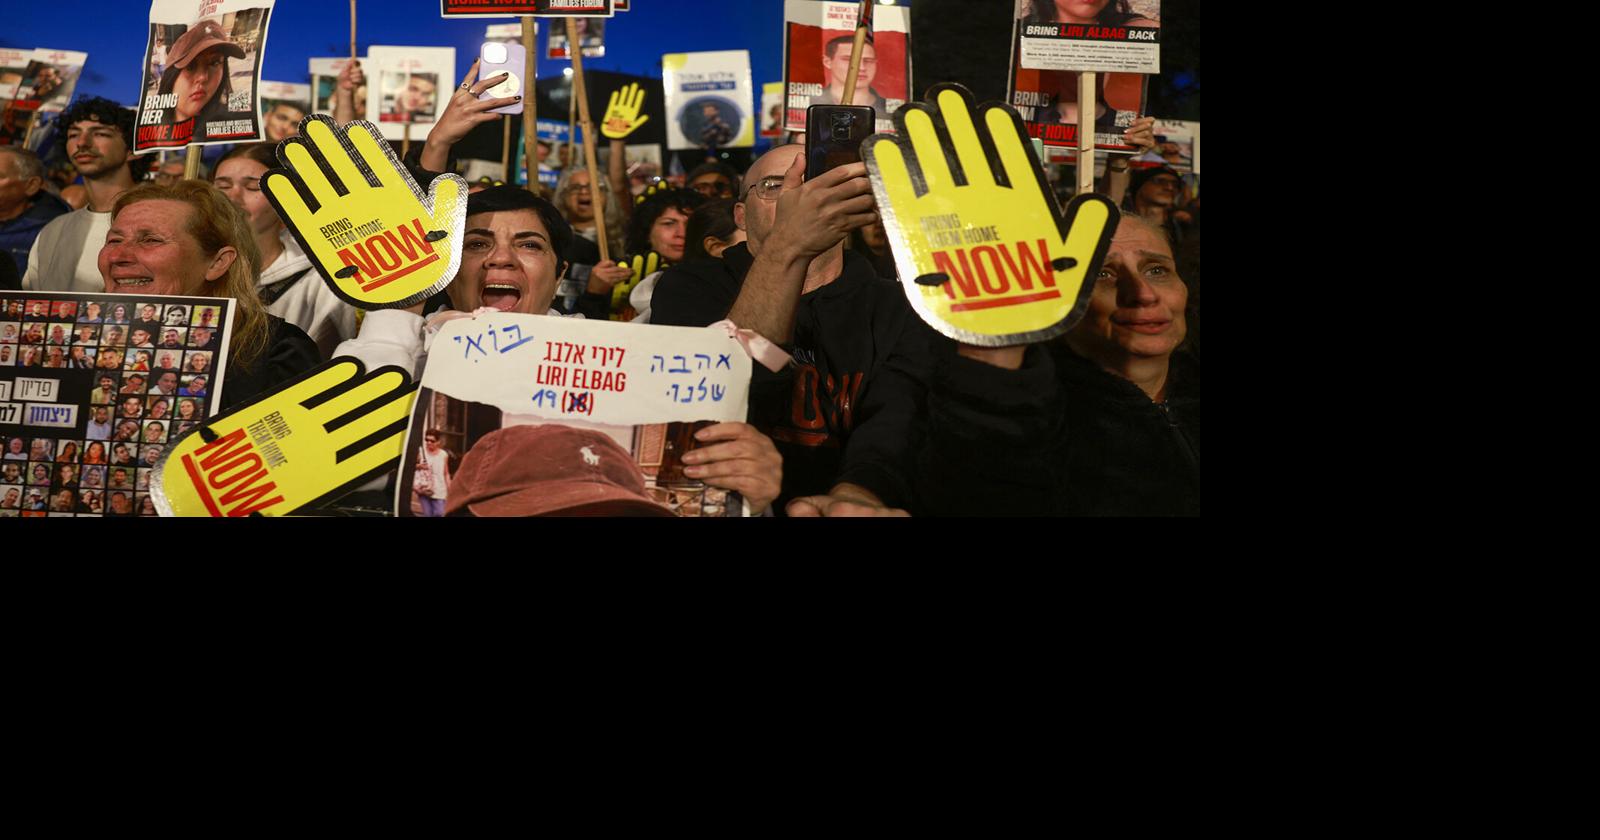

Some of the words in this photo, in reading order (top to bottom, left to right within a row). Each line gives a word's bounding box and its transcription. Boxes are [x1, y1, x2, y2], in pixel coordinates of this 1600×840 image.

[1026, 25, 1058, 36] BRING
[1060, 25, 1084, 37] LIRI
[1086, 26, 1126, 39] ALBAG
[1128, 30, 1156, 41] BACK
[789, 83, 823, 97] BRING
[1013, 91, 1049, 107] BRING
[144, 93, 179, 110] BRING
[788, 95, 811, 109] HIM
[140, 109, 164, 125] HER
[138, 124, 170, 143] HOME
[207, 126, 231, 137] FAMILIES
[231, 124, 254, 135] FORUM
[320, 217, 354, 238] BRING
[920, 213, 961, 232] BRING
[327, 231, 358, 250] THEM
[356, 219, 386, 242] HOME
[963, 225, 1001, 244] HOME
[336, 218, 435, 285] NOW
[930, 239, 1056, 300] NOW
[543, 341, 585, 364] אלבג
[591, 346, 626, 368] לירי
[650, 353, 731, 373] אהבה
[536, 365, 566, 387] LIRI
[572, 367, 627, 392] ELBAG
[20, 379, 52, 398] פדיון
[532, 388, 557, 408] 19
[29, 405, 72, 424] ניצחון
[263, 410, 293, 441] BRING
[247, 419, 273, 446] THEM
[260, 441, 288, 469] HOME
[193, 428, 285, 517] NOW
